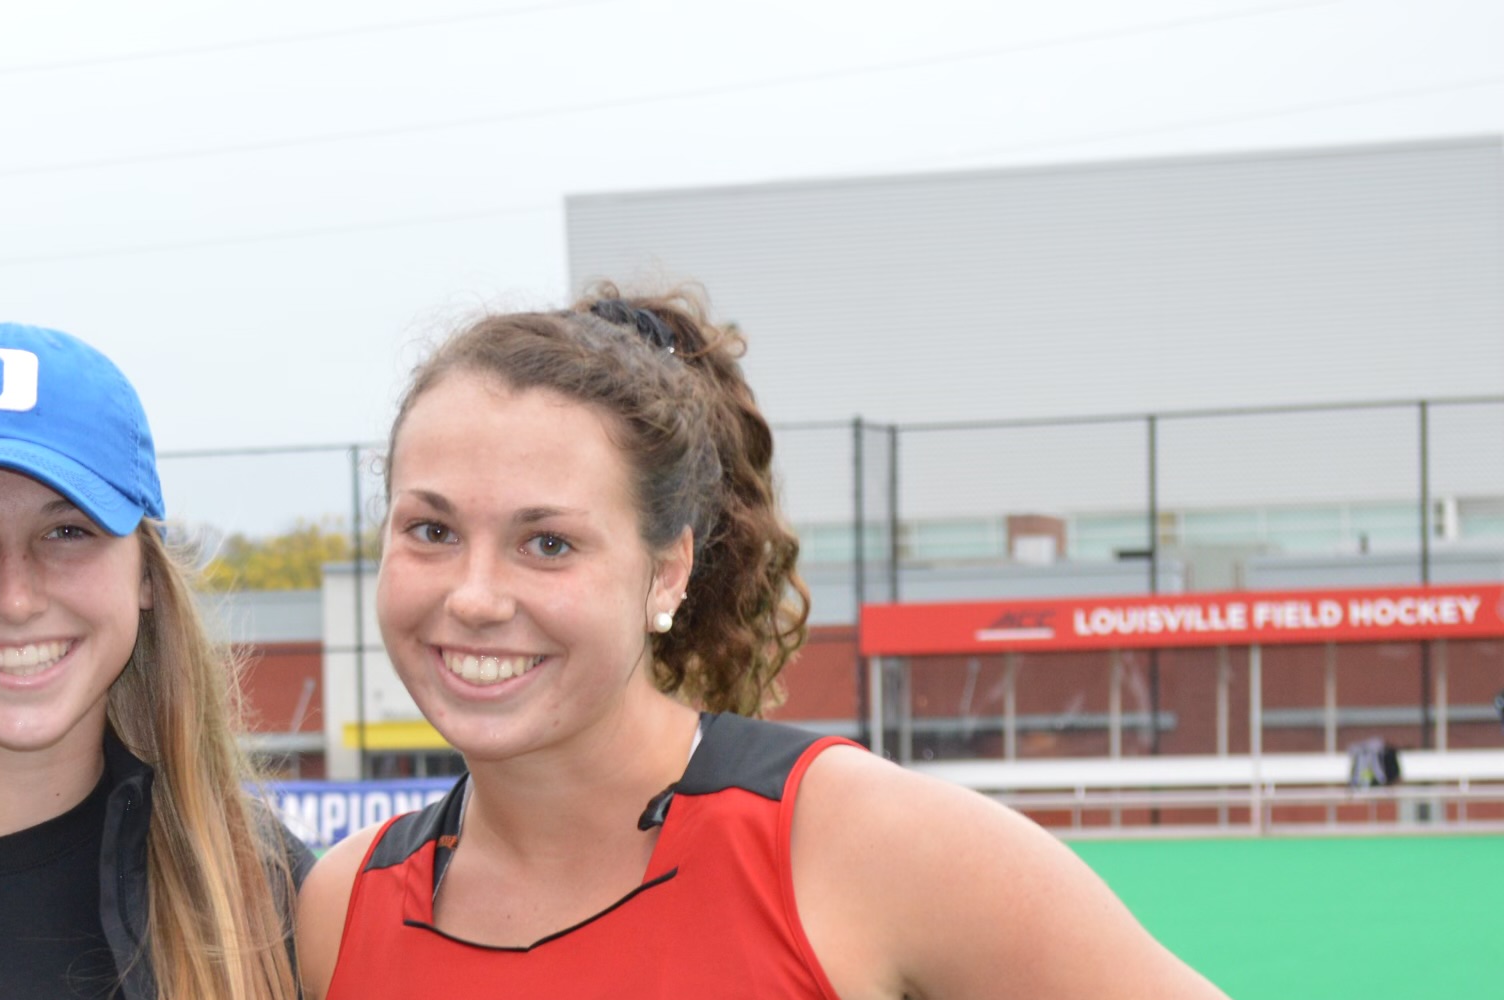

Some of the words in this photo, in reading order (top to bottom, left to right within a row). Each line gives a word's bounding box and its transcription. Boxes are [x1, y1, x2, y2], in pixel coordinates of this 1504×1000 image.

[1073, 602, 1248, 637] LOUISVILLE
[1252, 599, 1344, 630] FIELD
[1348, 595, 1482, 628] HOCKEY
